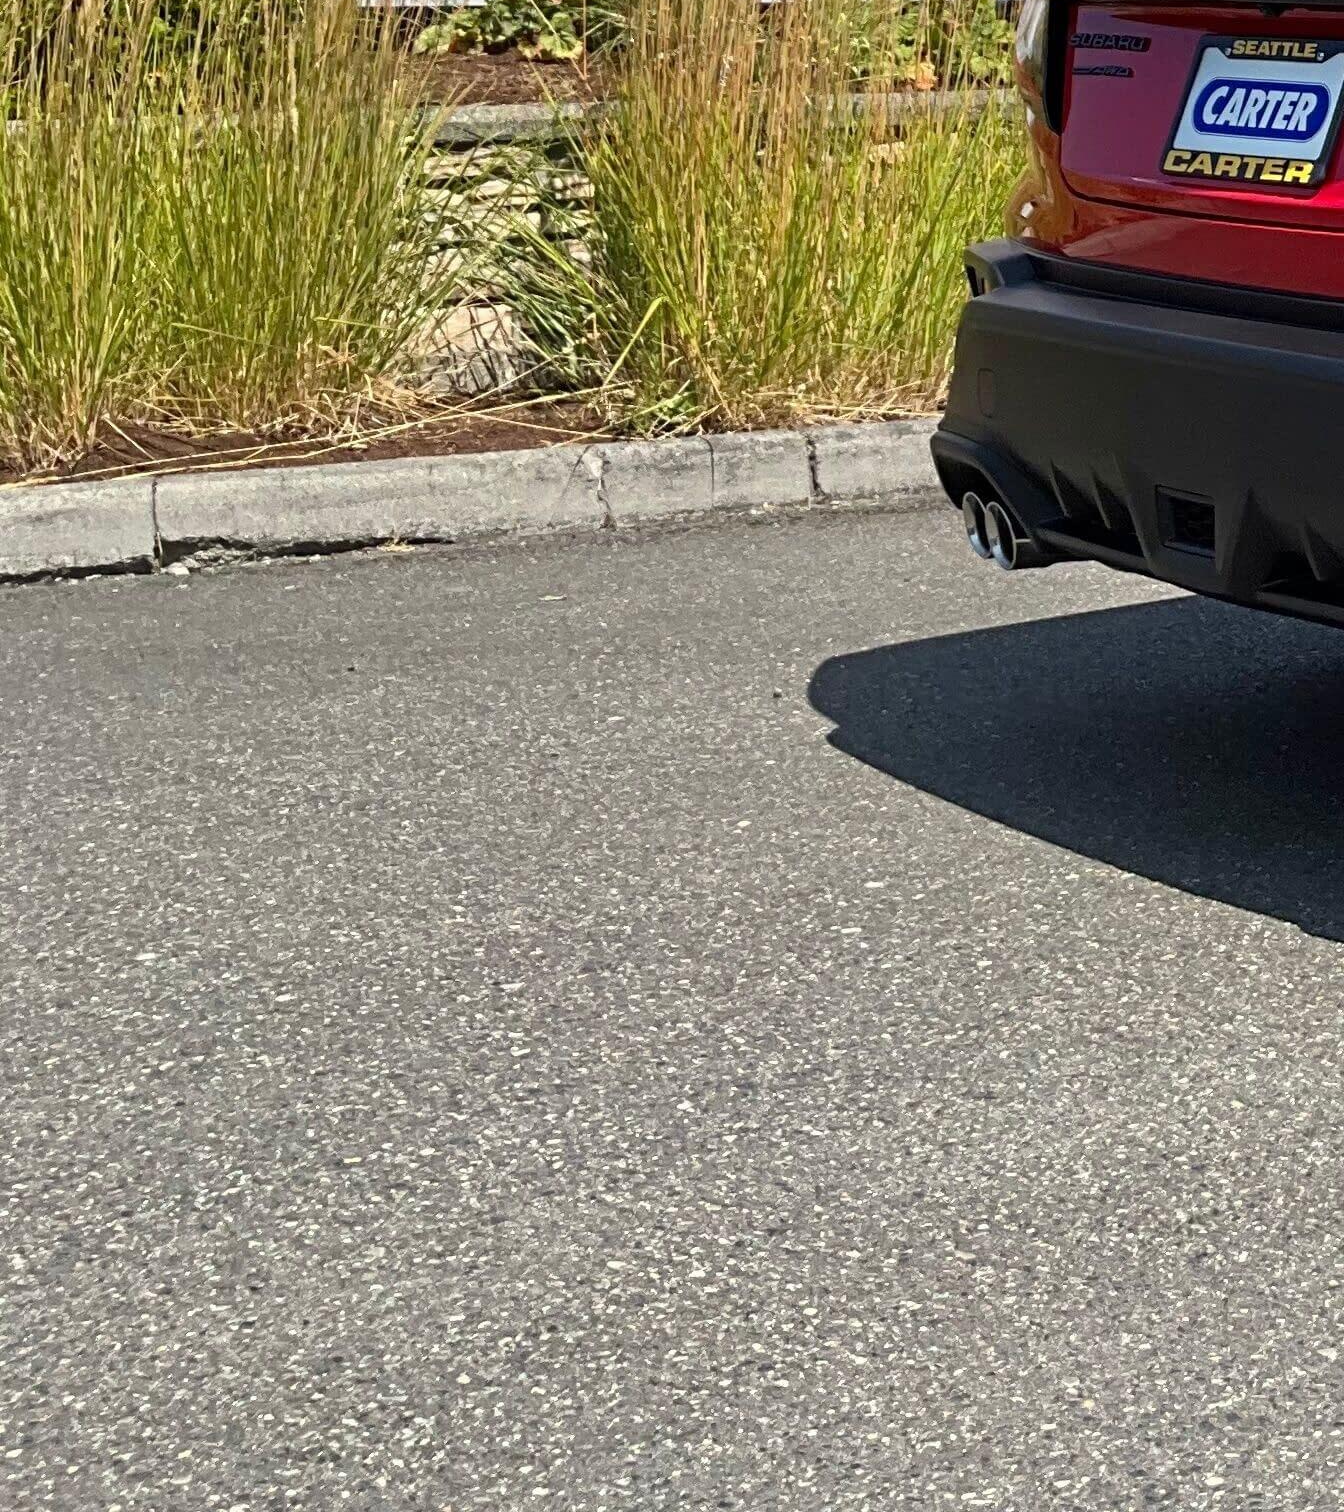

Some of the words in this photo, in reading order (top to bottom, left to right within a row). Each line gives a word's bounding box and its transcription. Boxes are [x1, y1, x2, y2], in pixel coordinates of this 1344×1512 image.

[1069, 33, 1152, 52] SUBARU
[1232, 40, 1318, 58] SEATTLE
[1202, 85, 1318, 132] CARTER
[1163, 149, 1315, 184] CARTER
